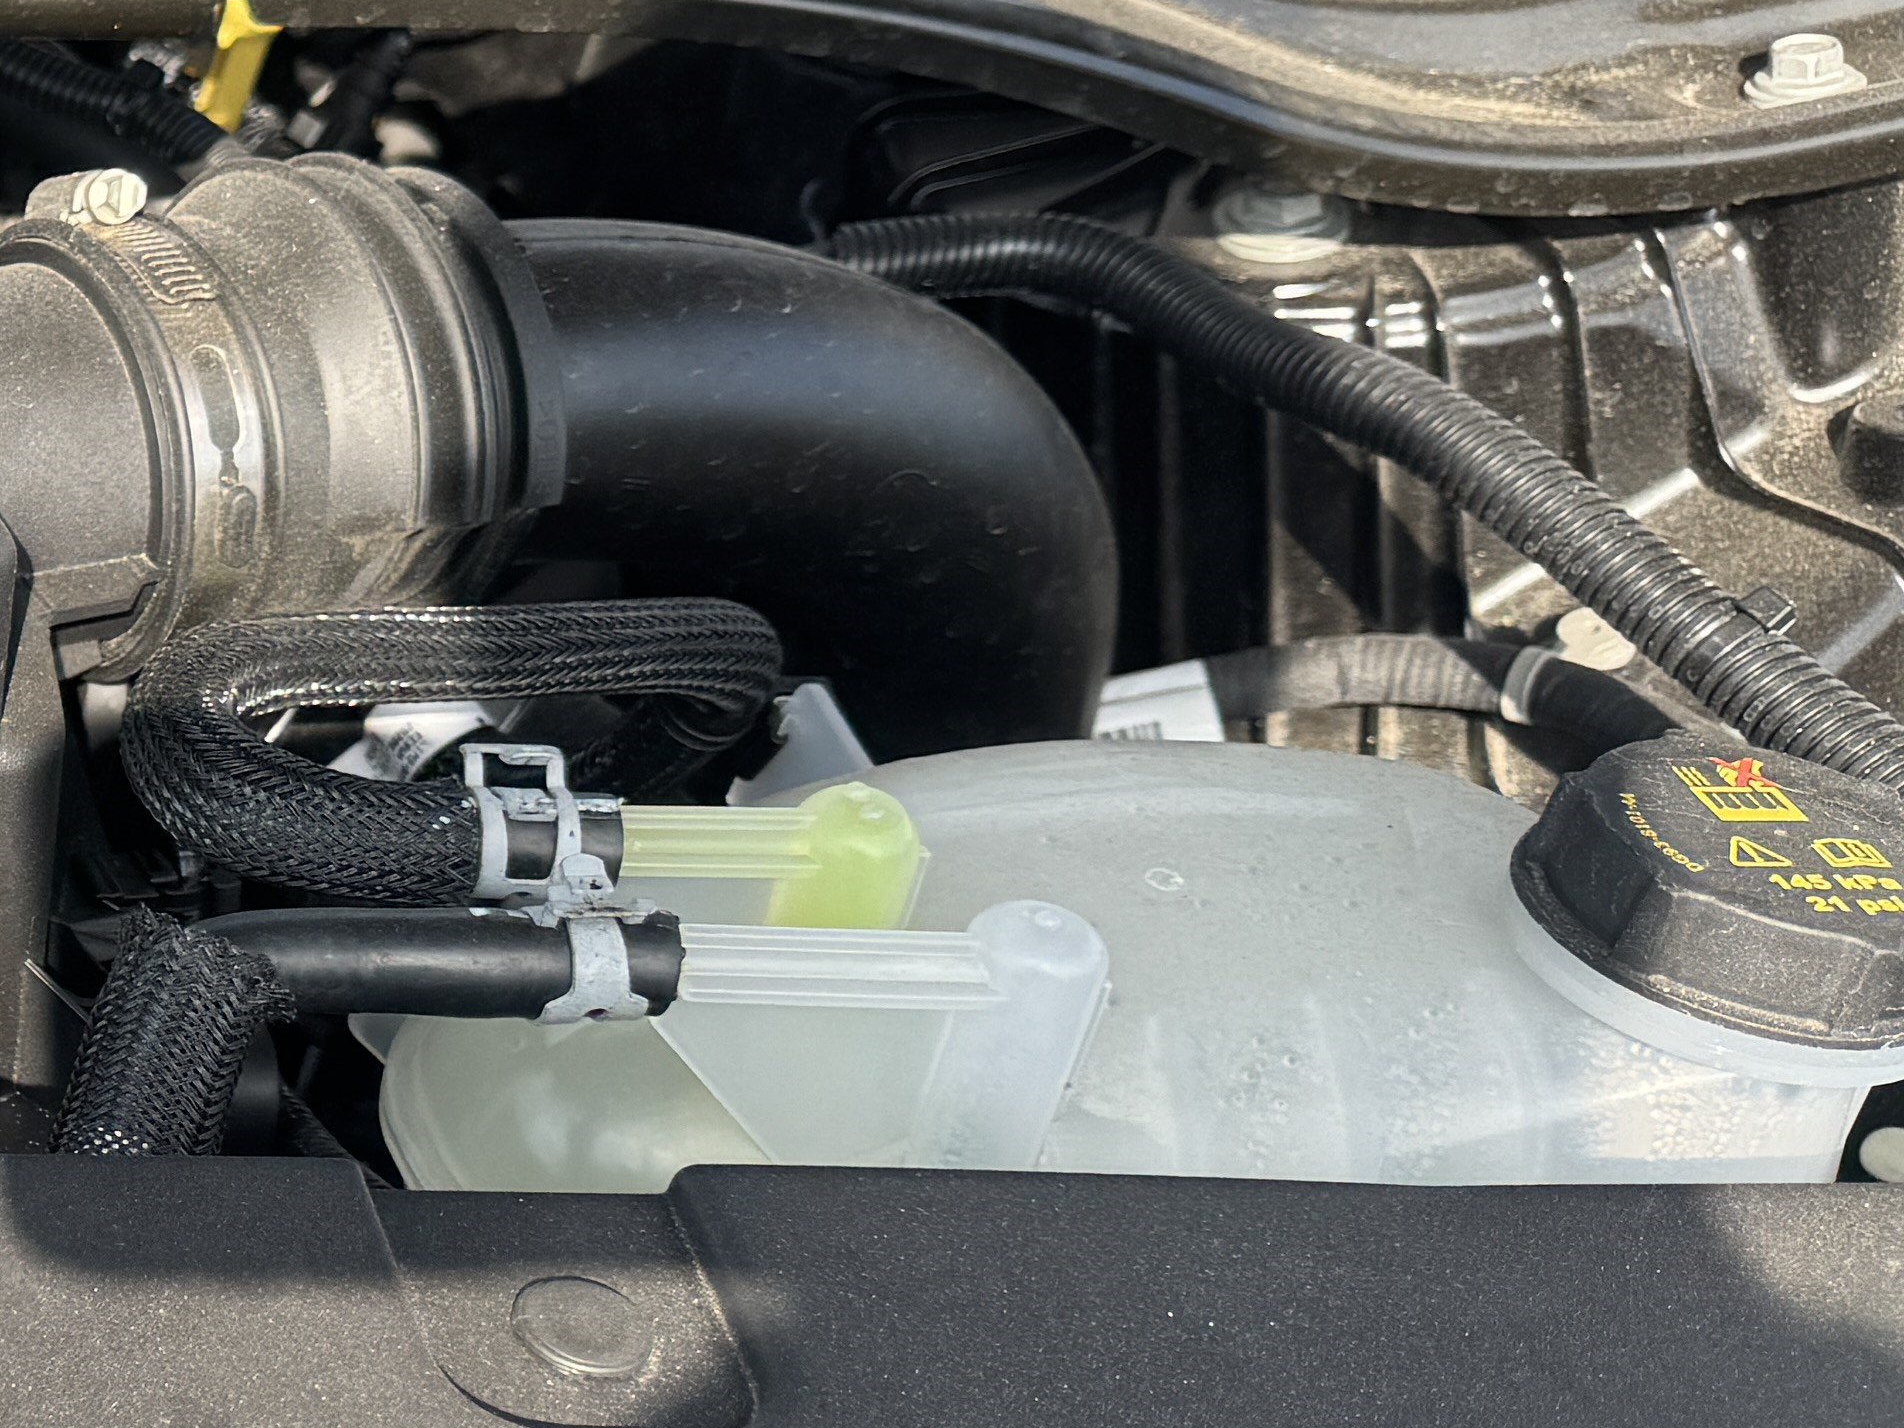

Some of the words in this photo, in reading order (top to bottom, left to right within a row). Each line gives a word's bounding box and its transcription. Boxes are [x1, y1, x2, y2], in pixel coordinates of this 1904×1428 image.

[1769, 873, 1833, 890] 145
[1832, 873, 1904, 890] kPa
[1805, 895, 1853, 913] 21
